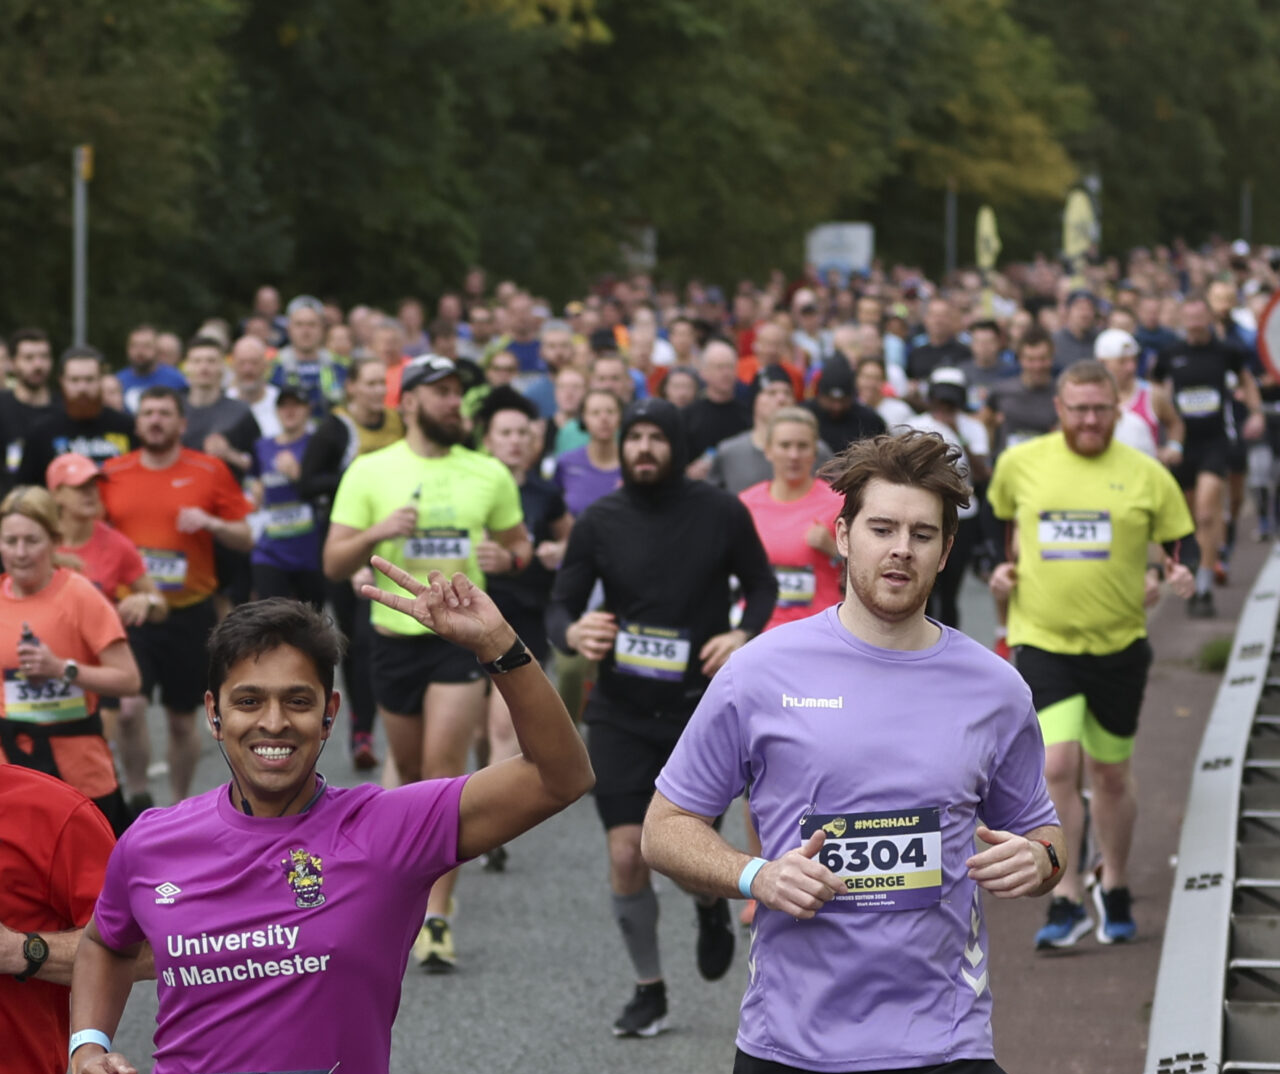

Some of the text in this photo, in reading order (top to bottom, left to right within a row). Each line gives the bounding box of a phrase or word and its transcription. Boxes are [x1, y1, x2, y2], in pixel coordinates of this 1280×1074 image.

[625, 638, 676, 659] 7336
[782, 694, 843, 708] hummel
[854, 816, 920, 830] #MCRHALF
[819, 838, 927, 873] 6304
[845, 876, 905, 889] GEORGE
[167, 924, 299, 957] University
[179, 954, 330, 987] Manchester
